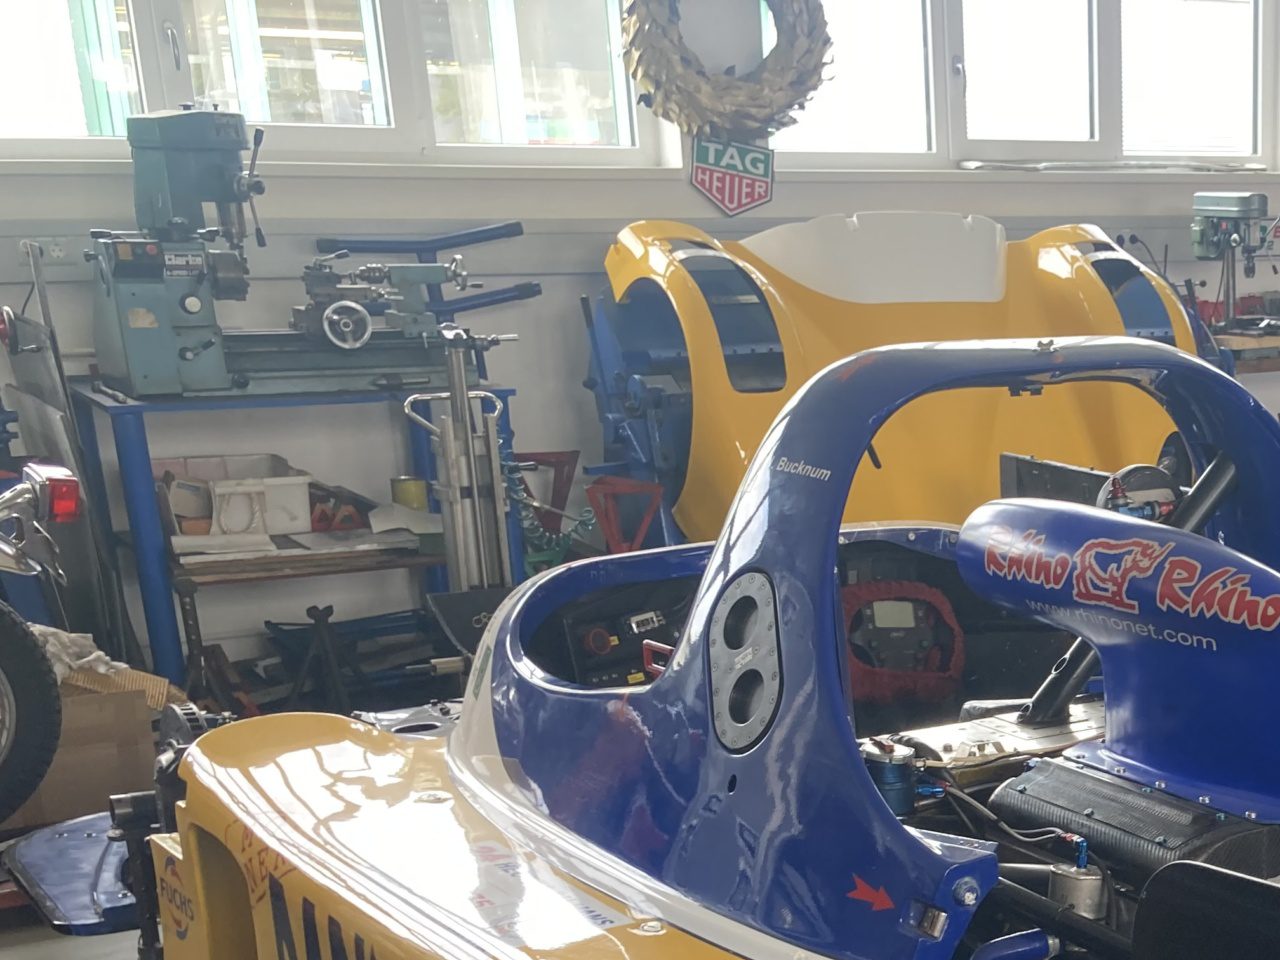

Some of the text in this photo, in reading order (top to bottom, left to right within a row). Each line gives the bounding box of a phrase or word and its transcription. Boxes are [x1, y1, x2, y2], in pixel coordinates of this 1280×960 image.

[701, 141, 765, 175] TAG
[697, 168, 767, 209] HEUER
[164, 253, 203, 266] Clarke
[776, 456, 832, 481] Bucknum
[984, 525, 1072, 590] Rhino
[159, 876, 194, 921] FUCHS
